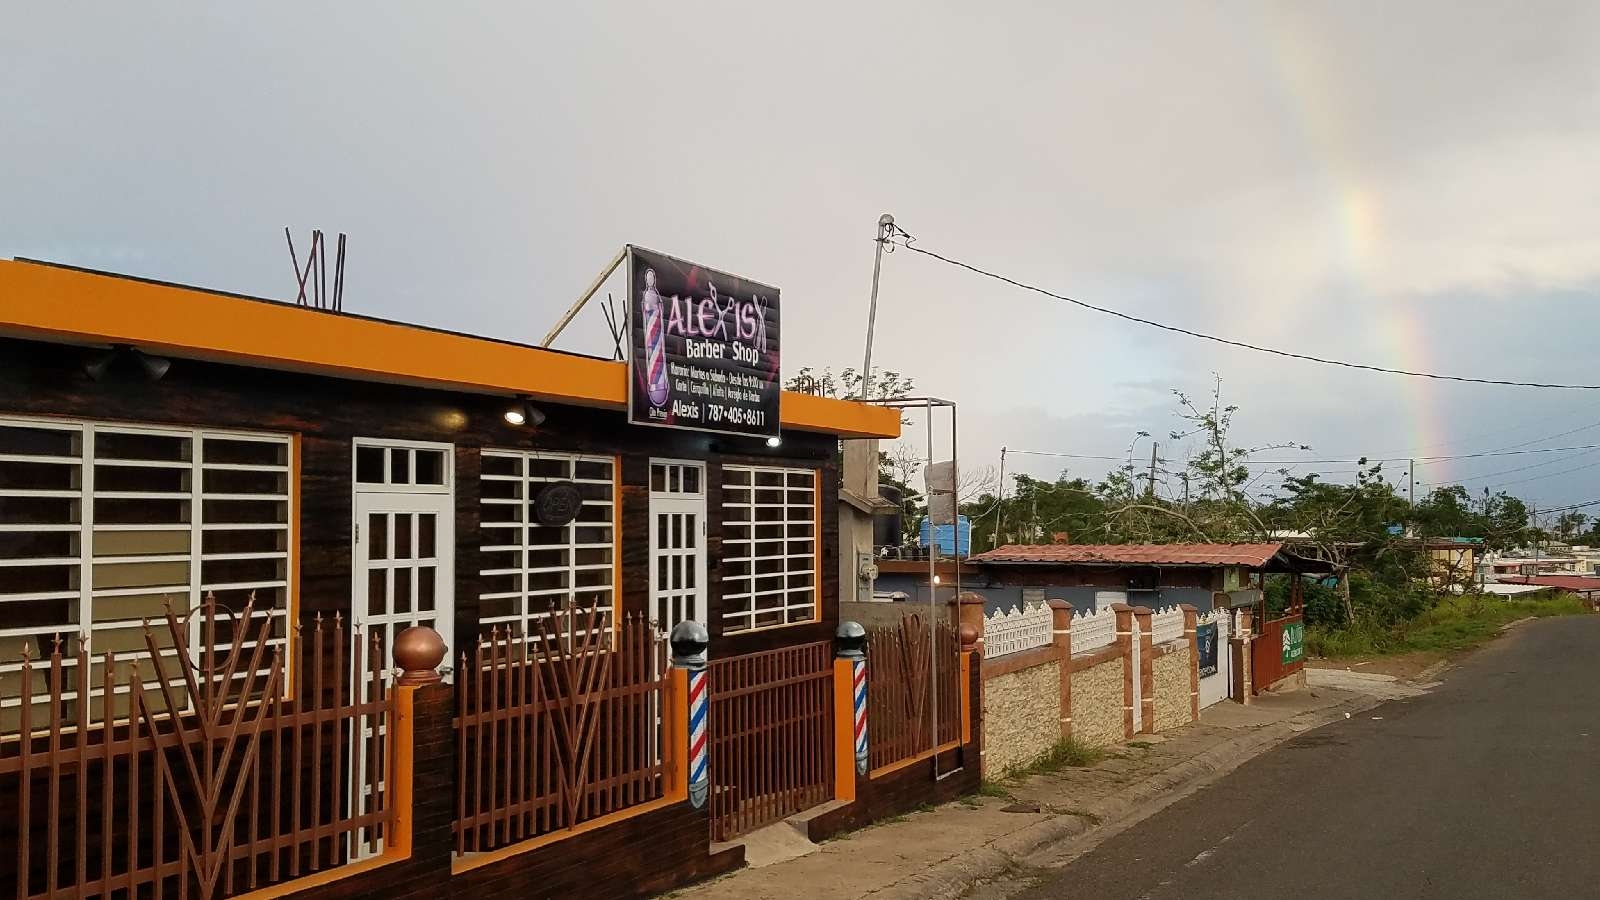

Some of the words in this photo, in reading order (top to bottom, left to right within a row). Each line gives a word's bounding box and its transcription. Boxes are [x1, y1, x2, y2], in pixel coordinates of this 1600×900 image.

[686, 339, 725, 359] Barber
[732, 341, 759, 366] Shop
[691, 366, 705, 380] Martes
[729, 372, 741, 386] Desde
[675, 378, 687, 392] Corte
[743, 389, 748, 401] de
[672, 400, 699, 419] Alexis
